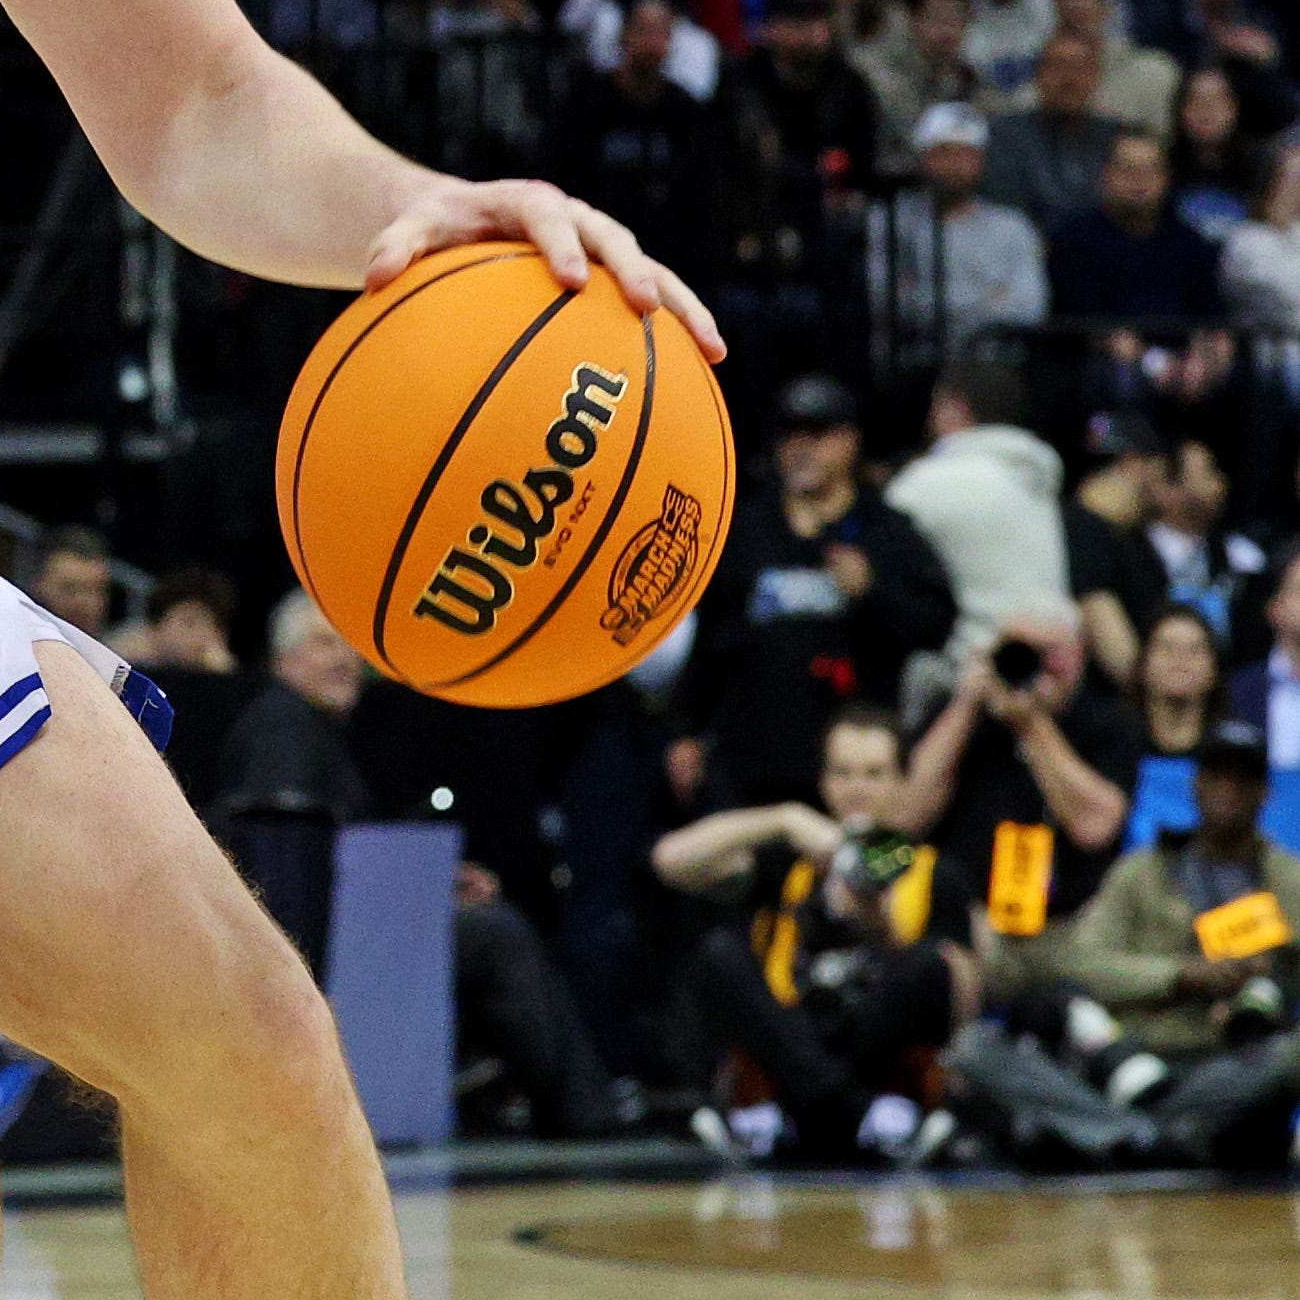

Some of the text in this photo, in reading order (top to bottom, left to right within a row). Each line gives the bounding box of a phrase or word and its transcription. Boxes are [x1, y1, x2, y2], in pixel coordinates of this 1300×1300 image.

[411, 362, 628, 636] Wilson
[638, 495, 701, 615] MADNESS
[618, 528, 673, 621] MARCH
